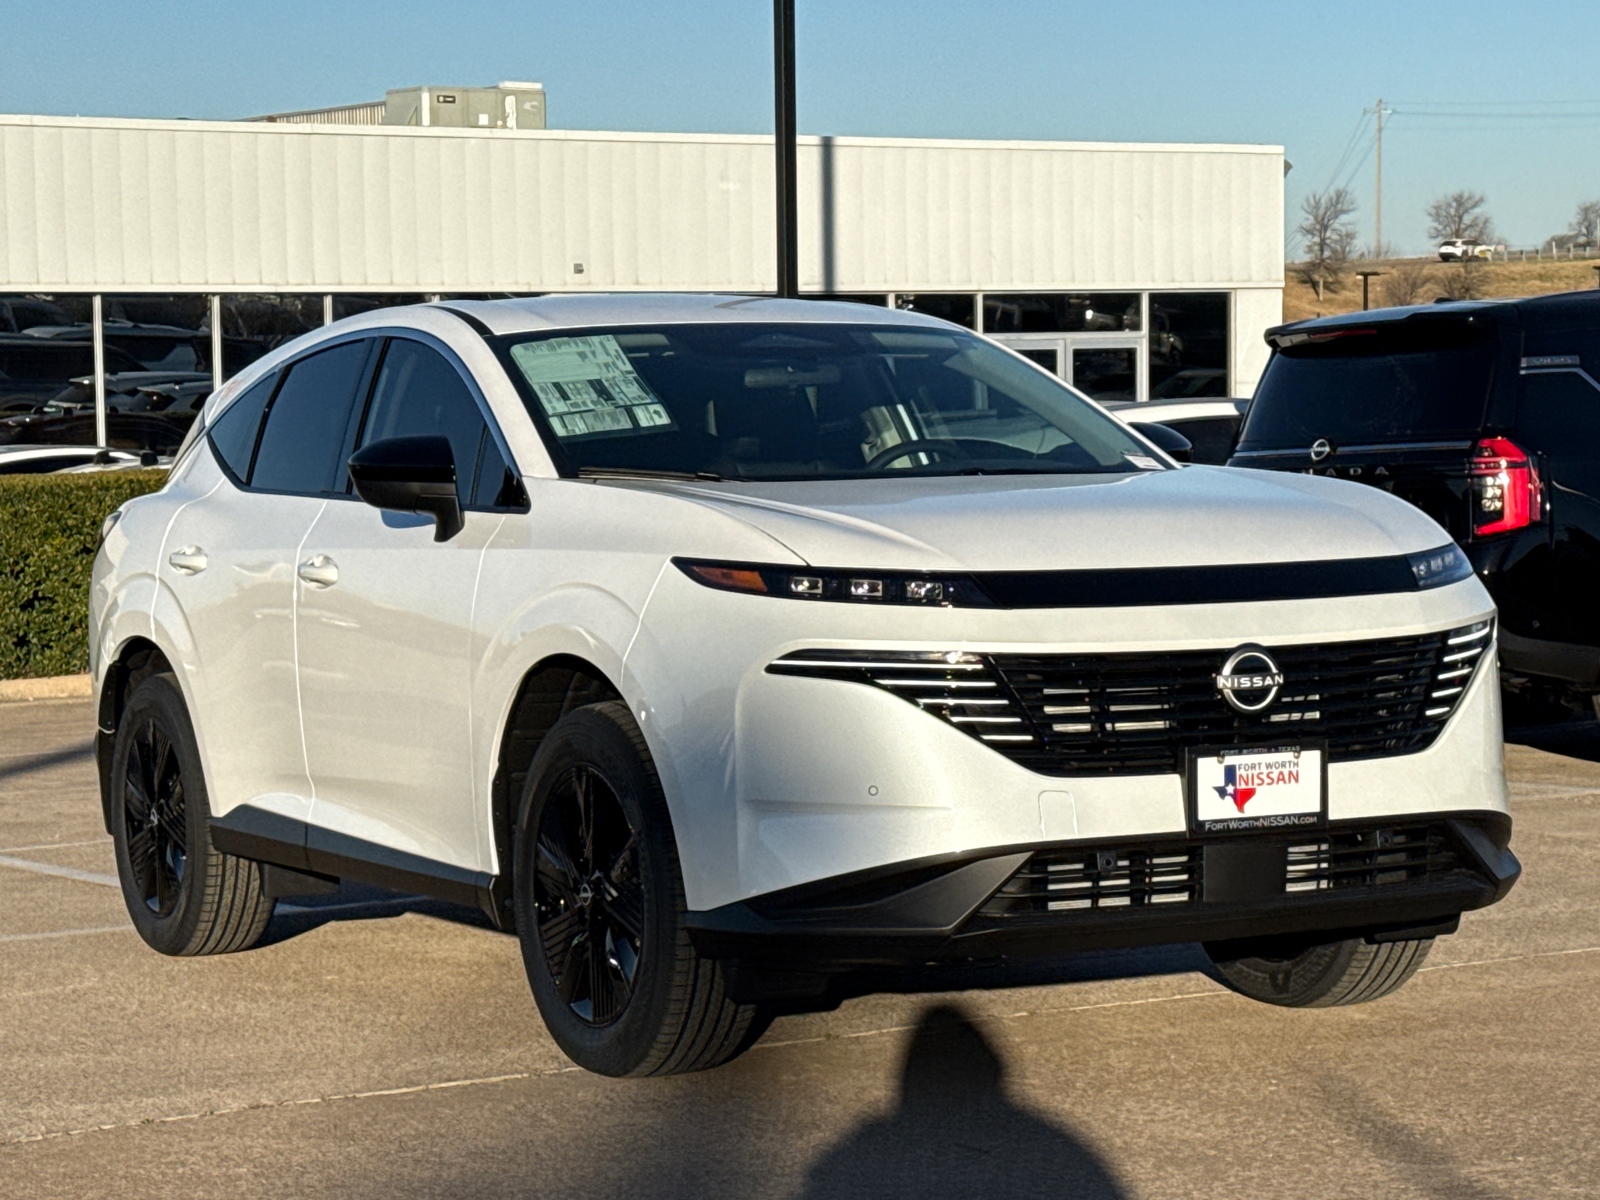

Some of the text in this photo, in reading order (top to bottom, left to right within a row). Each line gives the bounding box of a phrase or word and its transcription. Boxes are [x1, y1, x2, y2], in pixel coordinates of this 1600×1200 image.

[1219, 673, 1284, 688] NISSAN
[1237, 760, 1300, 772] FORT WORTH
[1238, 769, 1300, 787] NISSAN
